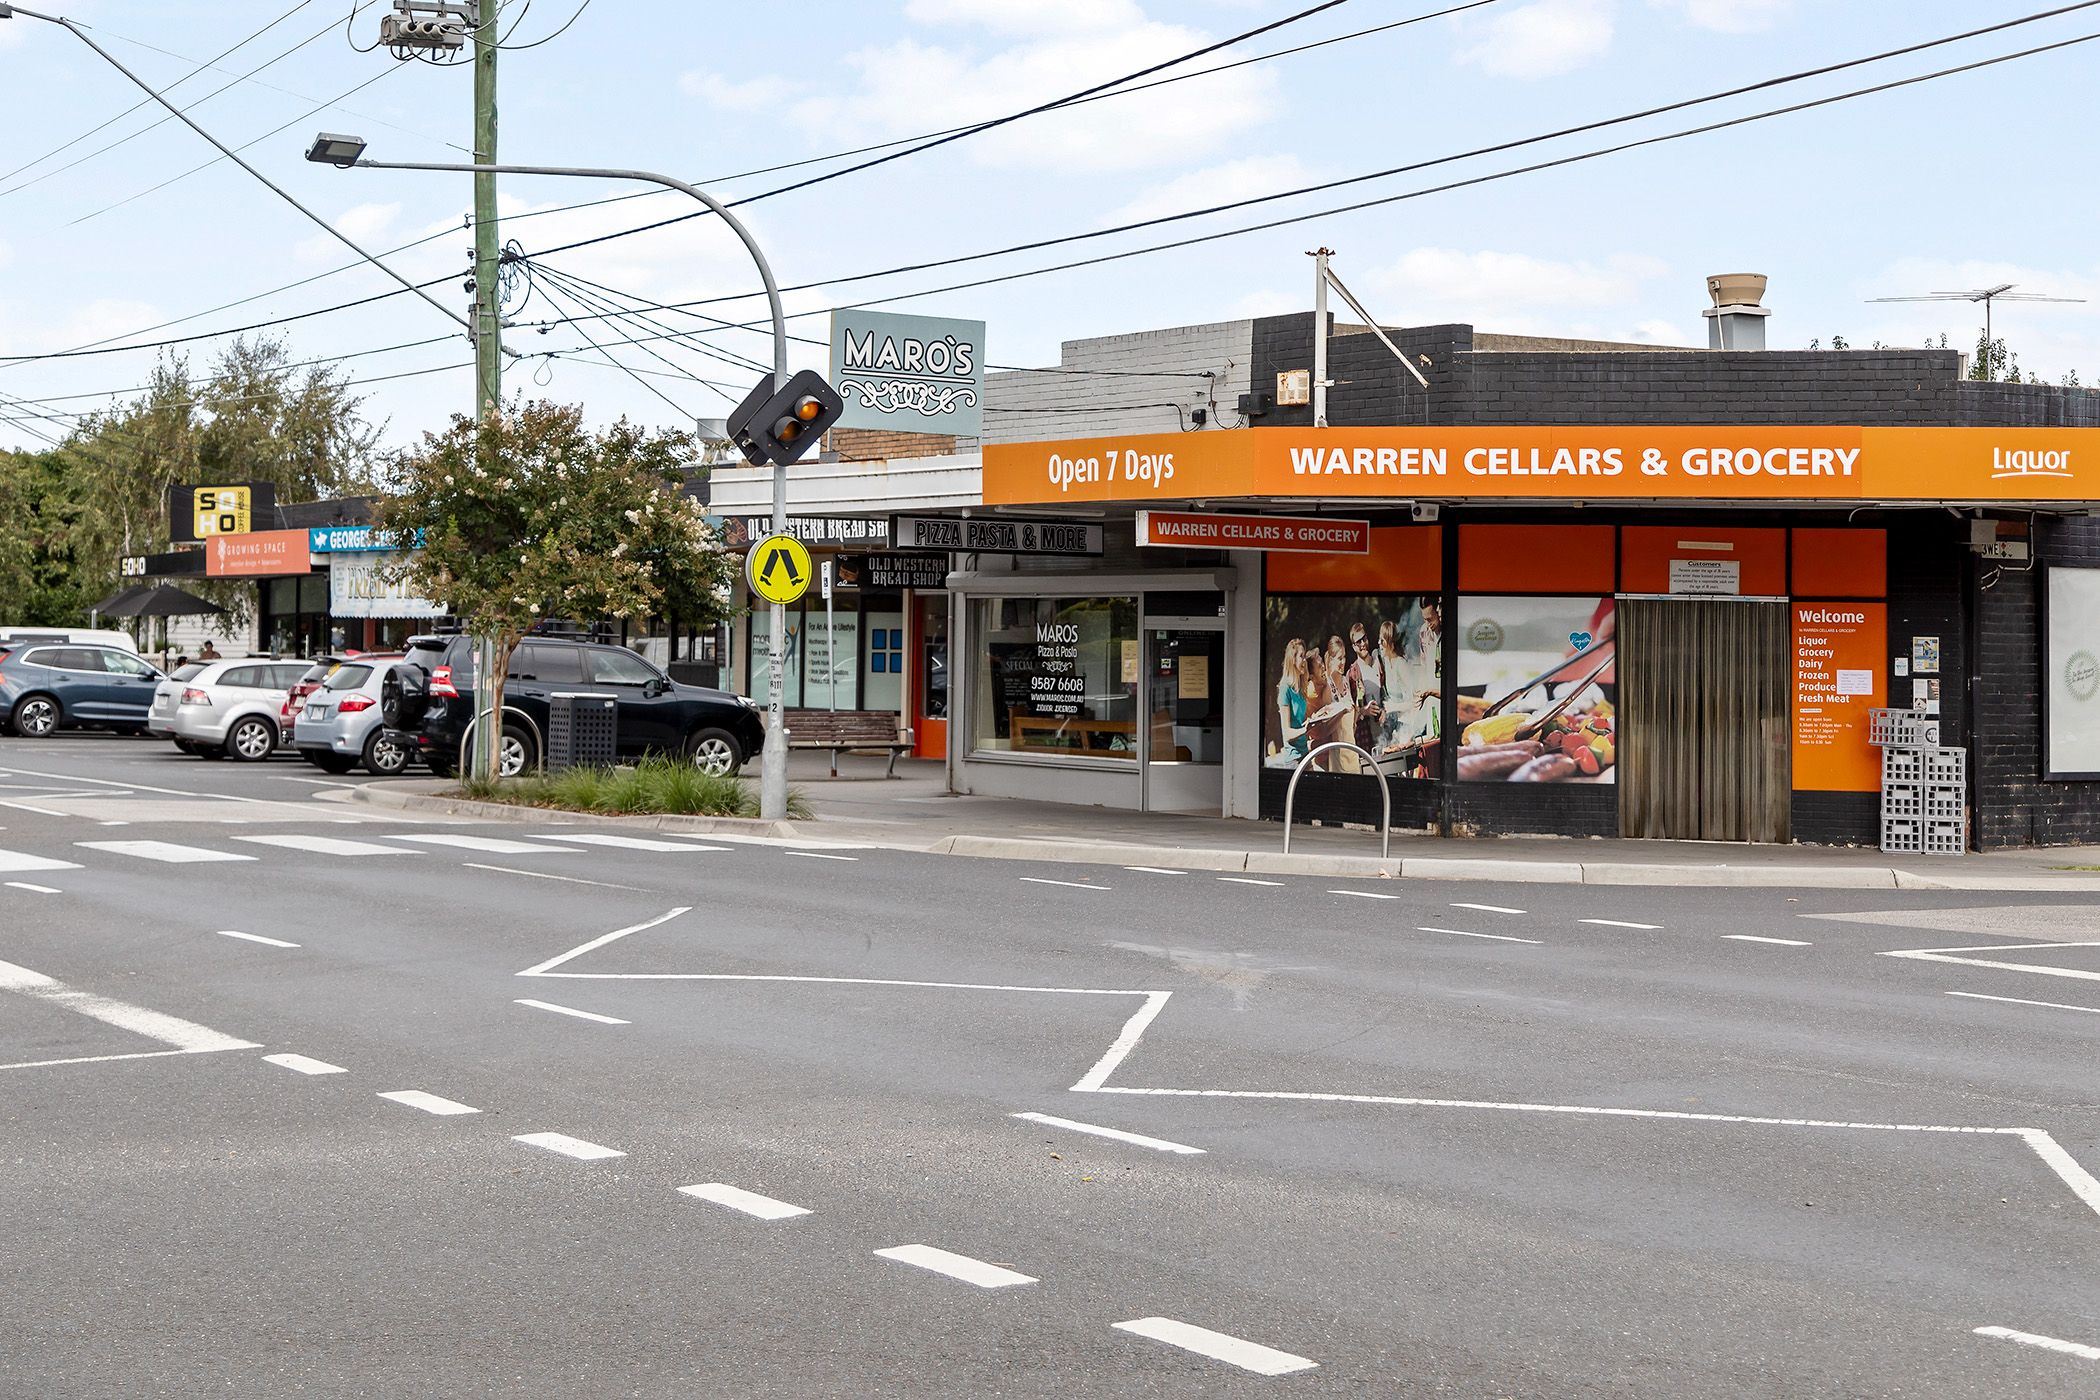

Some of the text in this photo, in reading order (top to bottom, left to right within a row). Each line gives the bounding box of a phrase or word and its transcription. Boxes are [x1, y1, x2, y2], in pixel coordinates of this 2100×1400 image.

[1290, 447, 1861, 476] WARREN CELLARS & GROCERY
[1993, 447, 2071, 473] Liquor
[1048, 449, 1175, 491] Open 7 Days
[747, 518, 889, 543] OLD STERN BREAD SH
[915, 520, 1087, 551] PIZZA PASTA & MORE
[1157, 522, 1360, 543] WARREN CELLARS & GROCERY
[226, 541, 286, 556] GROWING SPACE
[121, 556, 146, 576] SOHO
[868, 557, 946, 574] OLD WESTERN
[872, 571, 942, 587] BREAD SHOP
[1799, 609, 1865, 623] Welcome
[1036, 622, 1079, 643] MAROS
[1799, 636, 1827, 647] Liquor
[1037, 645, 1078, 658] Pizza & Pasta
[1799, 648, 1834, 659] Grocery
[1799, 659, 1823, 670] Dairy
[1799, 671, 1829, 680] Frozen
[1031, 676, 1056, 690] 9587
[1057, 677, 1084, 692] 6608
[1799, 682, 1836, 691] Produce
[1799, 693, 1850, 703] Fresh Meat
